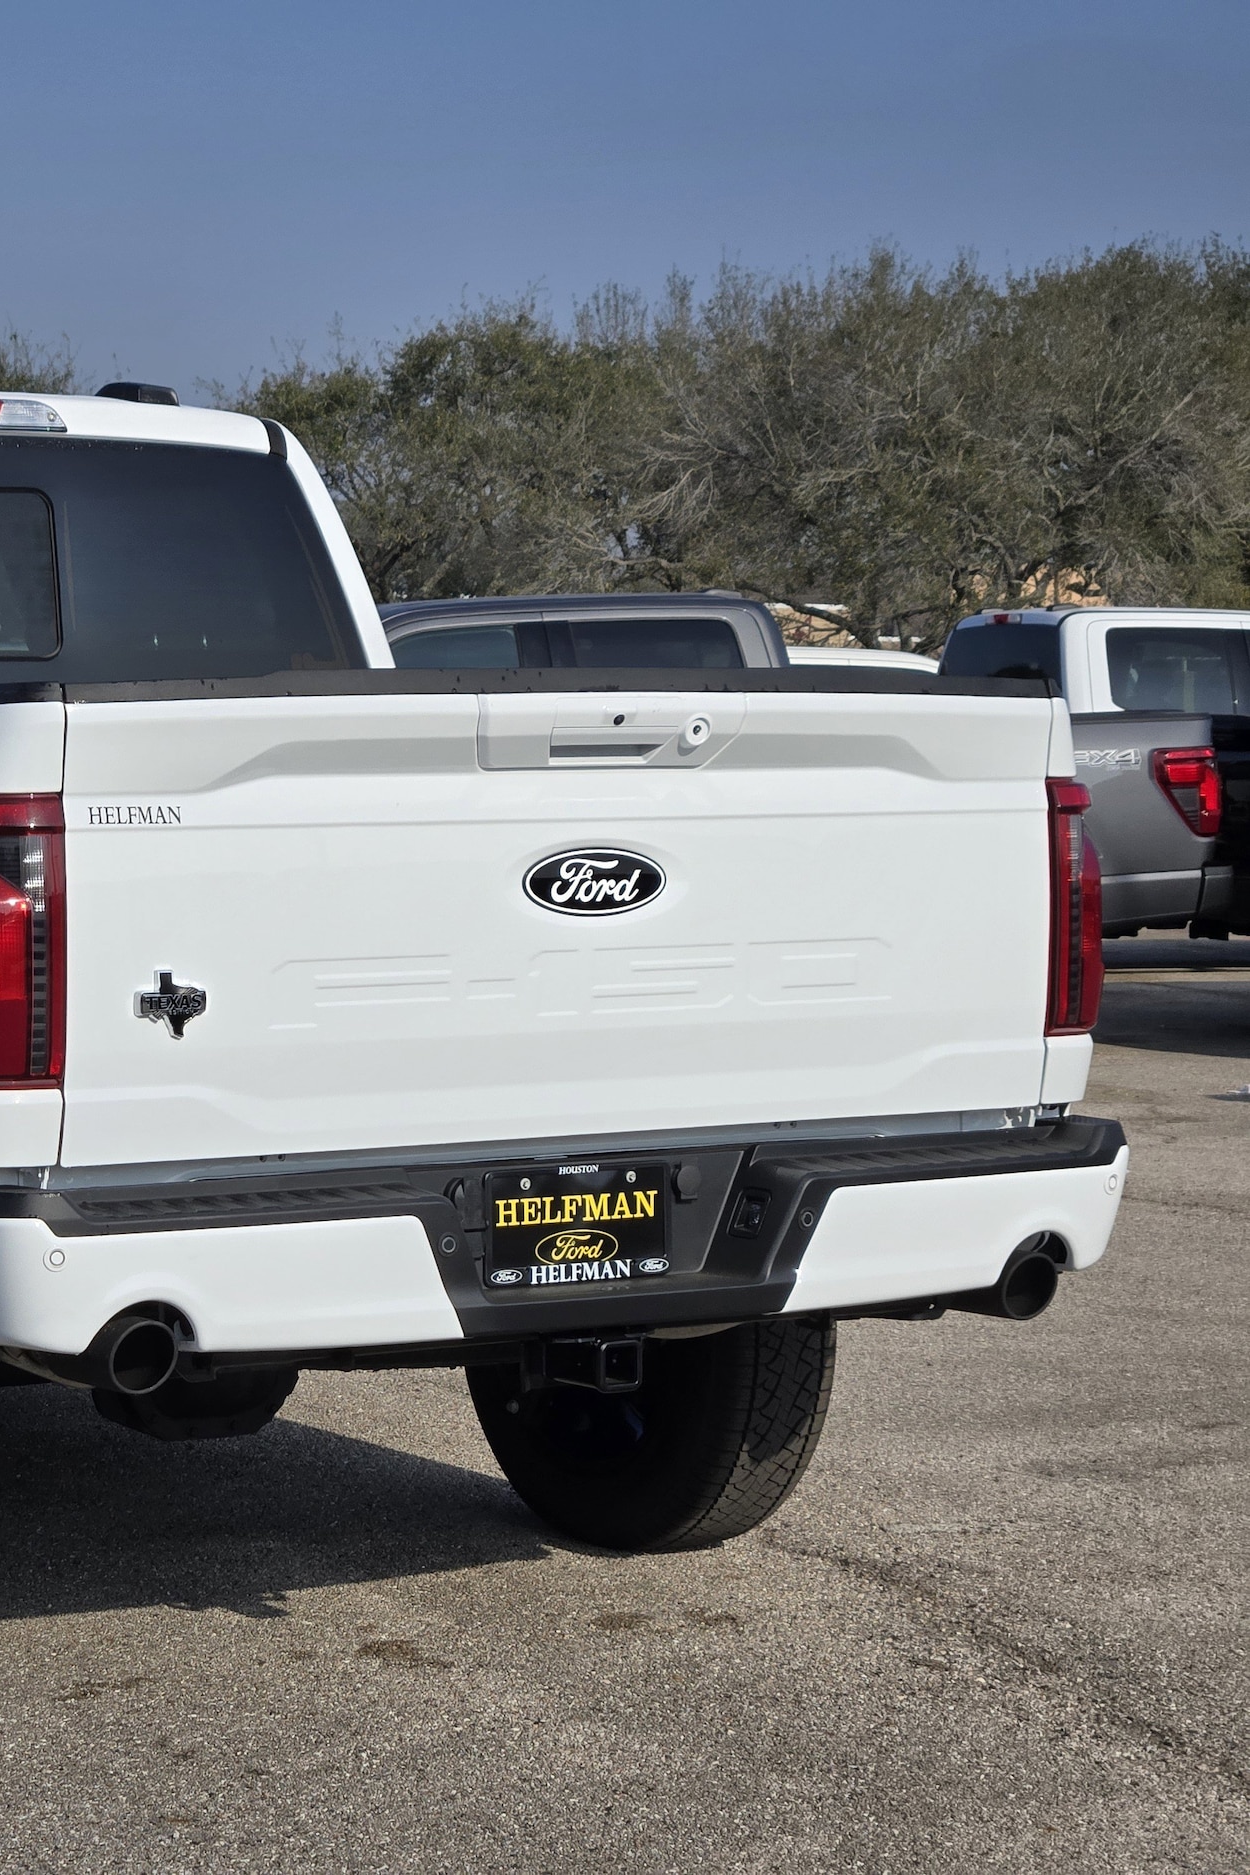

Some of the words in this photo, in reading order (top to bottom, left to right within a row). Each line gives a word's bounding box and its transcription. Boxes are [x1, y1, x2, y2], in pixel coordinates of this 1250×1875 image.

[88, 806, 182, 825] HELFMAN
[551, 858, 641, 902] Ford
[145, 994, 203, 1010] TEXAS
[558, 1164, 599, 1175] HOUSTON
[495, 1190, 658, 1227] HELFMAN
[551, 1234, 603, 1260] Ford
[530, 1259, 632, 1285] HELFMAN
